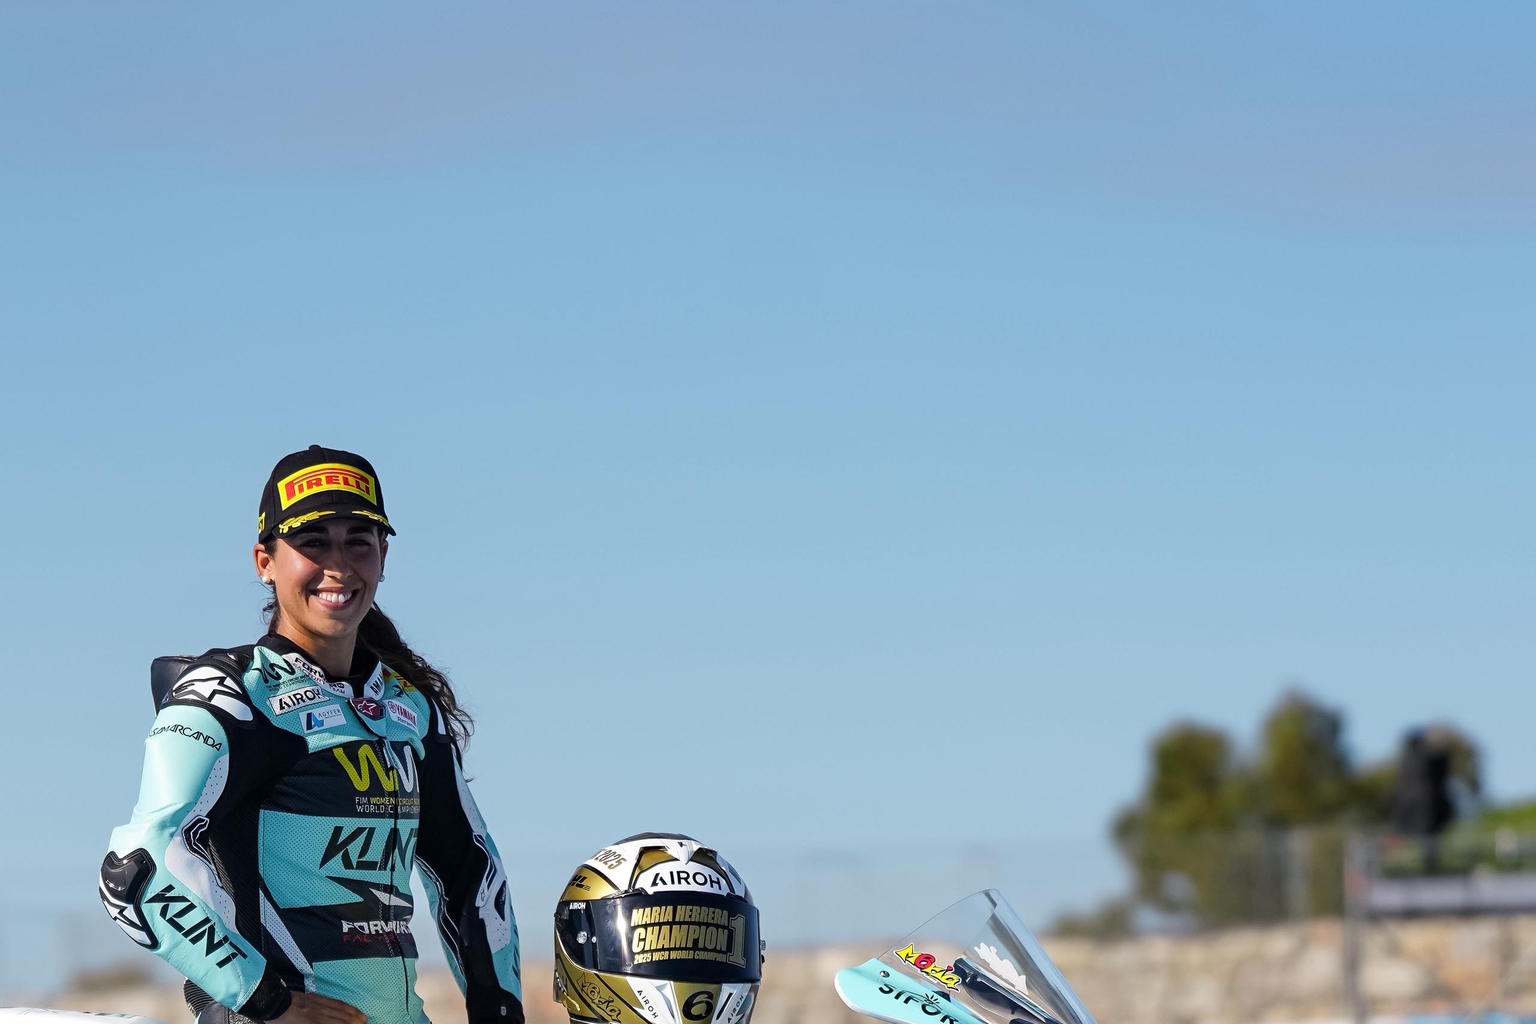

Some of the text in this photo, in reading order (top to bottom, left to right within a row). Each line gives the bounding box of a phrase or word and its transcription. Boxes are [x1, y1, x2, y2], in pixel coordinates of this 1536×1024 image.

[285, 467, 370, 501] PIRELLI
[650, 870, 721, 891] AIROH
[569, 902, 586, 910] AIROH
[631, 905, 728, 927] MARIA HERRERA
[144, 884, 248, 969] KLINT
[632, 924, 728, 953] CHAMPION
[727, 913, 746, 968] 1
[634, 952, 651, 965] 2025
[670, 950, 694, 961] WORLD
[694, 951, 727, 963] CHAMPION
[637, 989, 659, 1020] AIROH
[727, 994, 744, 1024] AIROH
